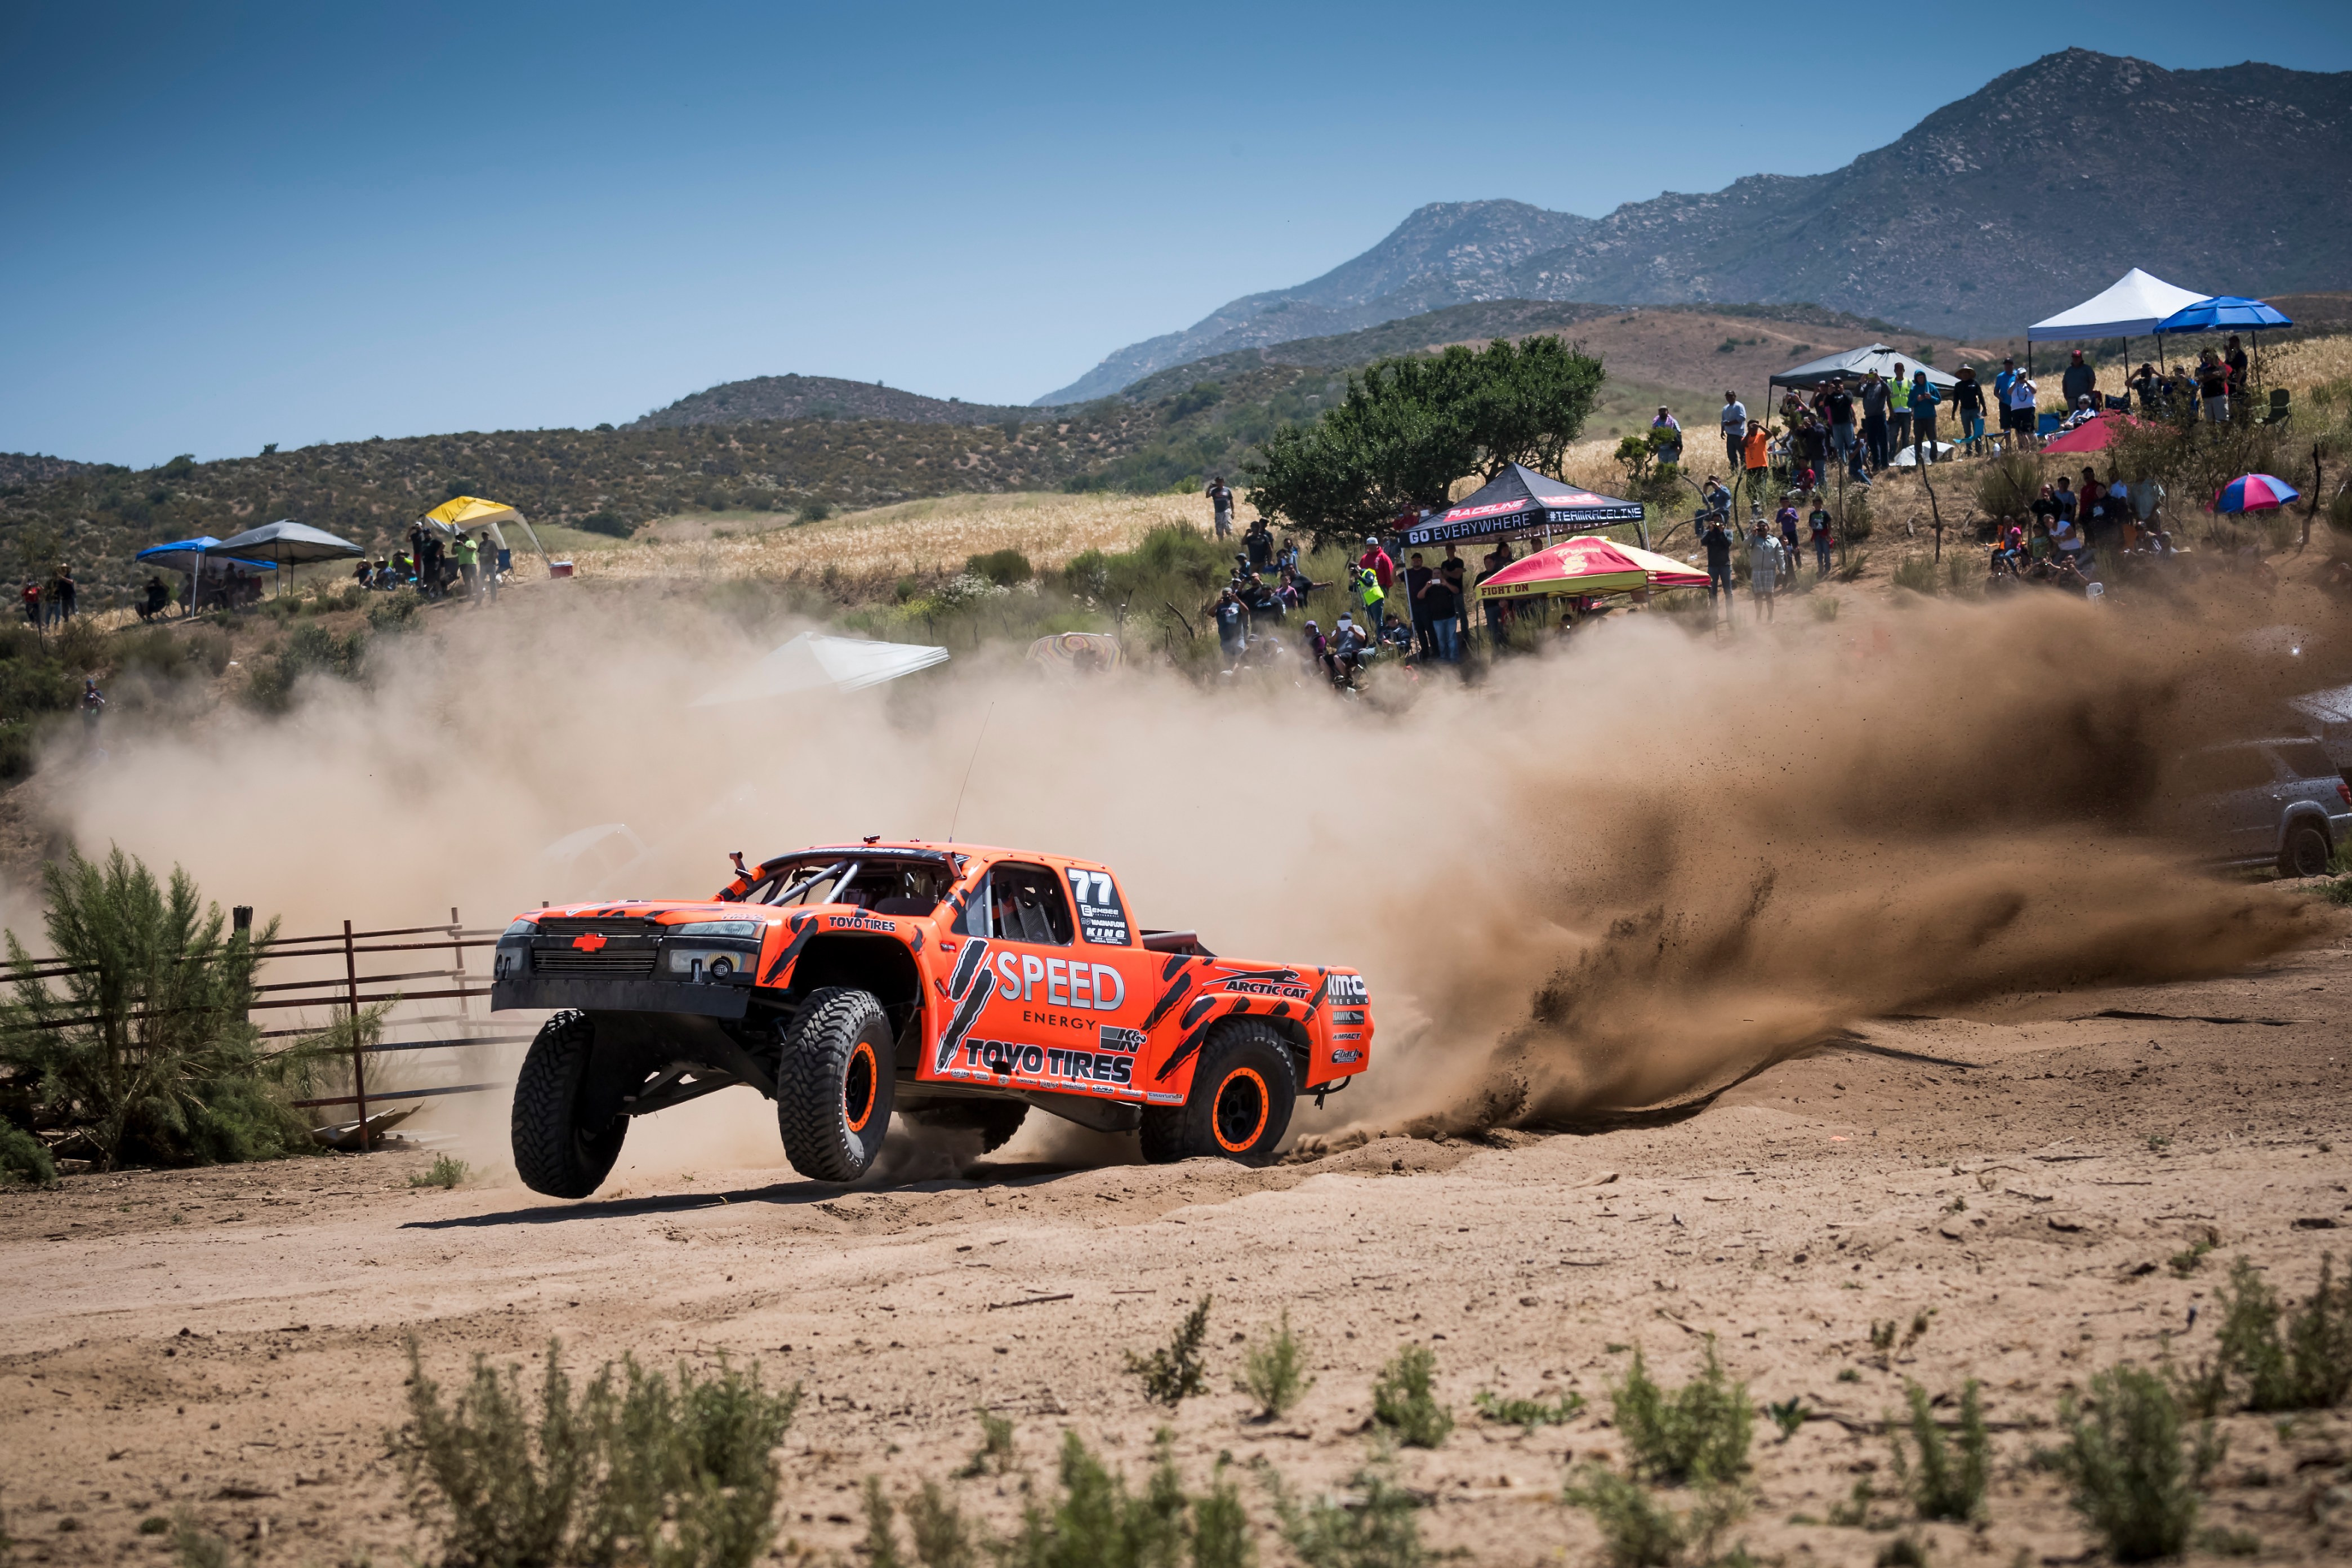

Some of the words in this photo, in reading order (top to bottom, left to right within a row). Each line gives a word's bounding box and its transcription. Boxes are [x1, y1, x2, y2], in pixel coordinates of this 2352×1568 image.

[1448, 499, 1528, 518] RACELINE
[1549, 507, 1642, 522] #TEAMRACELINE
[1409, 531, 1429, 545] GO
[1434, 513, 1531, 541] EVERYWHERE
[1554, 547, 1602, 557] Trojans
[1481, 584, 1511, 596] FIGHT
[1515, 583, 1529, 593] ON
[1068, 868, 1113, 906] 77
[829, 916, 862, 929] TOYO
[864, 919, 896, 932] TIRES
[1086, 928, 1125, 938] KING
[997, 952, 1125, 1011] SPEED
[1225, 981, 1281, 995] ARCTIC
[1282, 987, 1310, 999] CAT
[1023, 1011, 1096, 1030] ENERGY
[1333, 1012, 1351, 1021] HAWK
[965, 1039, 1044, 1074] TOYO
[1047, 1049, 1134, 1085] TIRES
